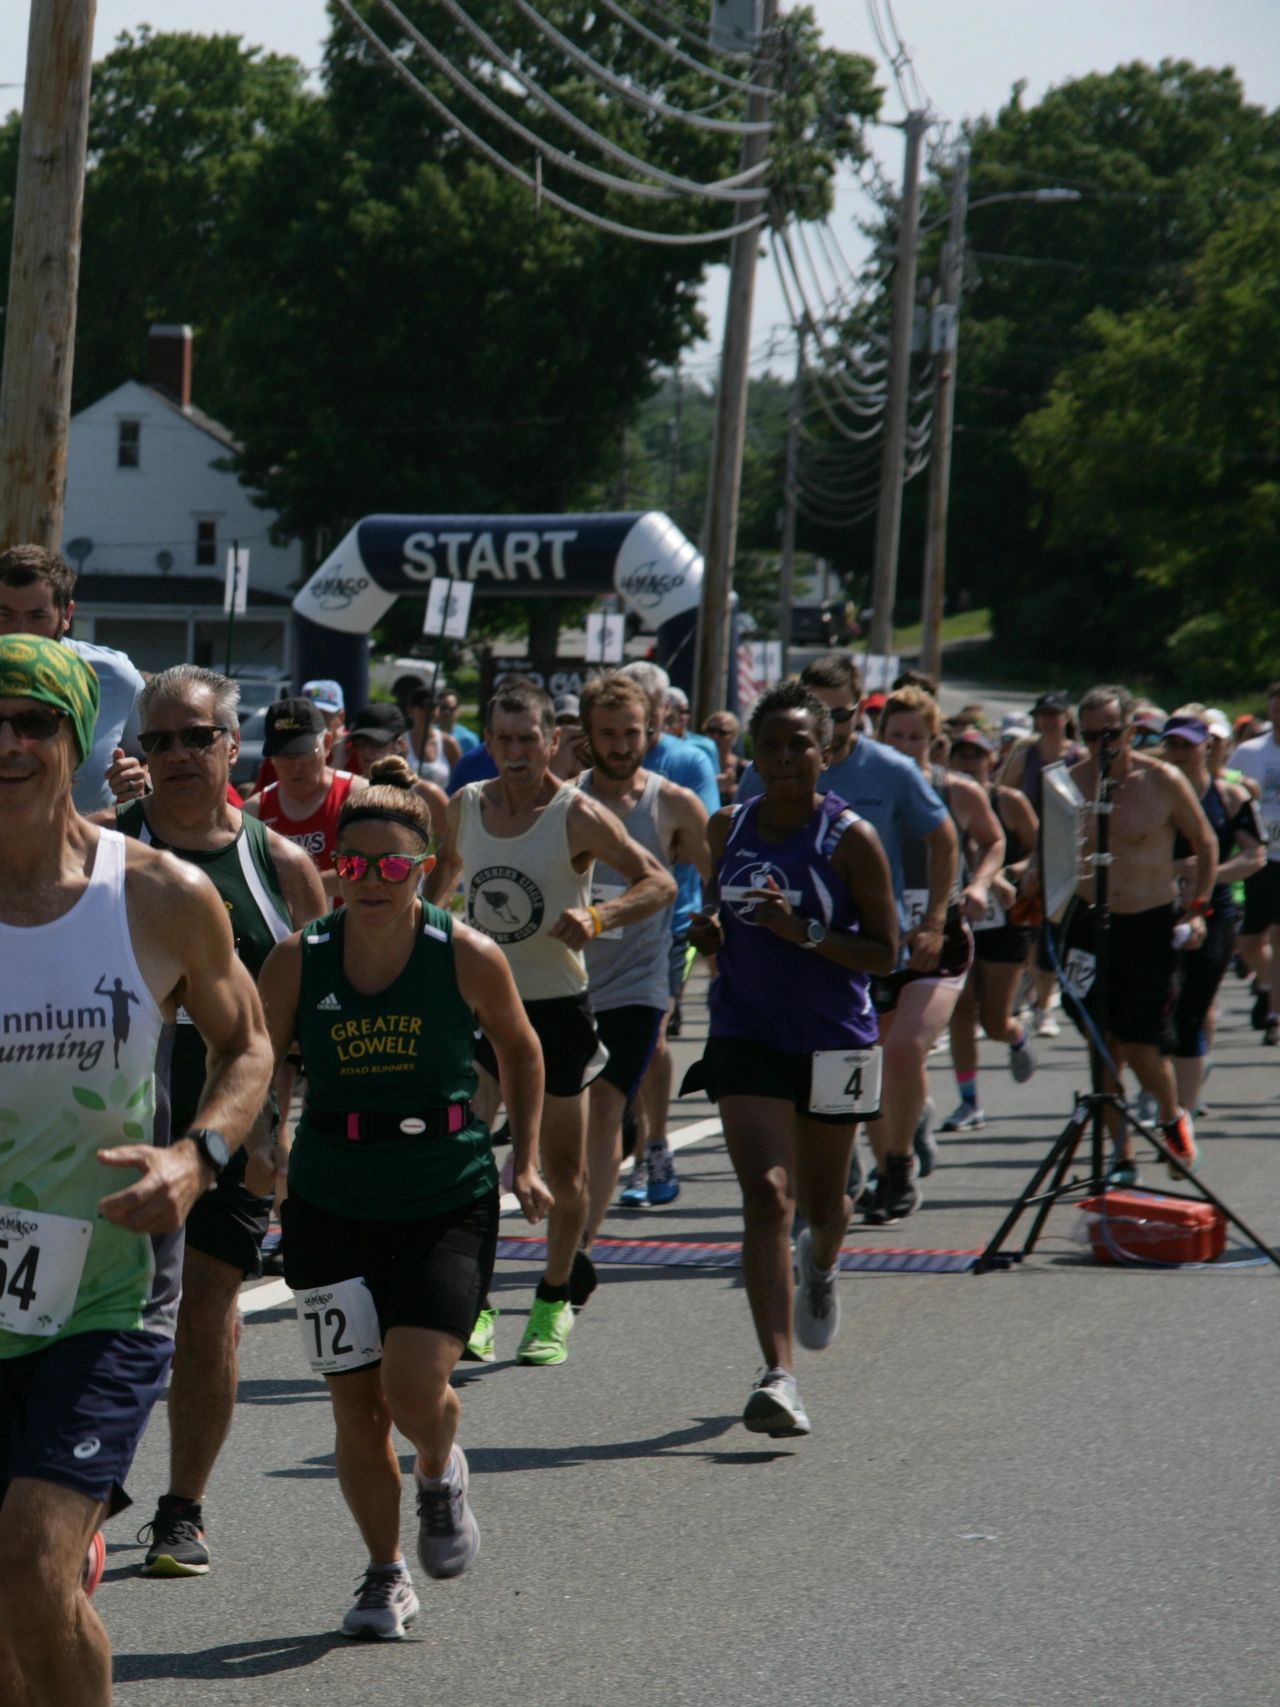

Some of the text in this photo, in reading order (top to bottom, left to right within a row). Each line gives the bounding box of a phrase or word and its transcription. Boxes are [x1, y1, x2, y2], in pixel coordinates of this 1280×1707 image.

[401, 530, 579, 581] START
[330, 1014, 423, 1042] GREATER
[336, 1035, 419, 1062] LOWELL
[339, 1063, 416, 1075] ROAD RUNNERS
[844, 1067, 863, 1101] 4
[304, 1308, 354, 1358] 72
